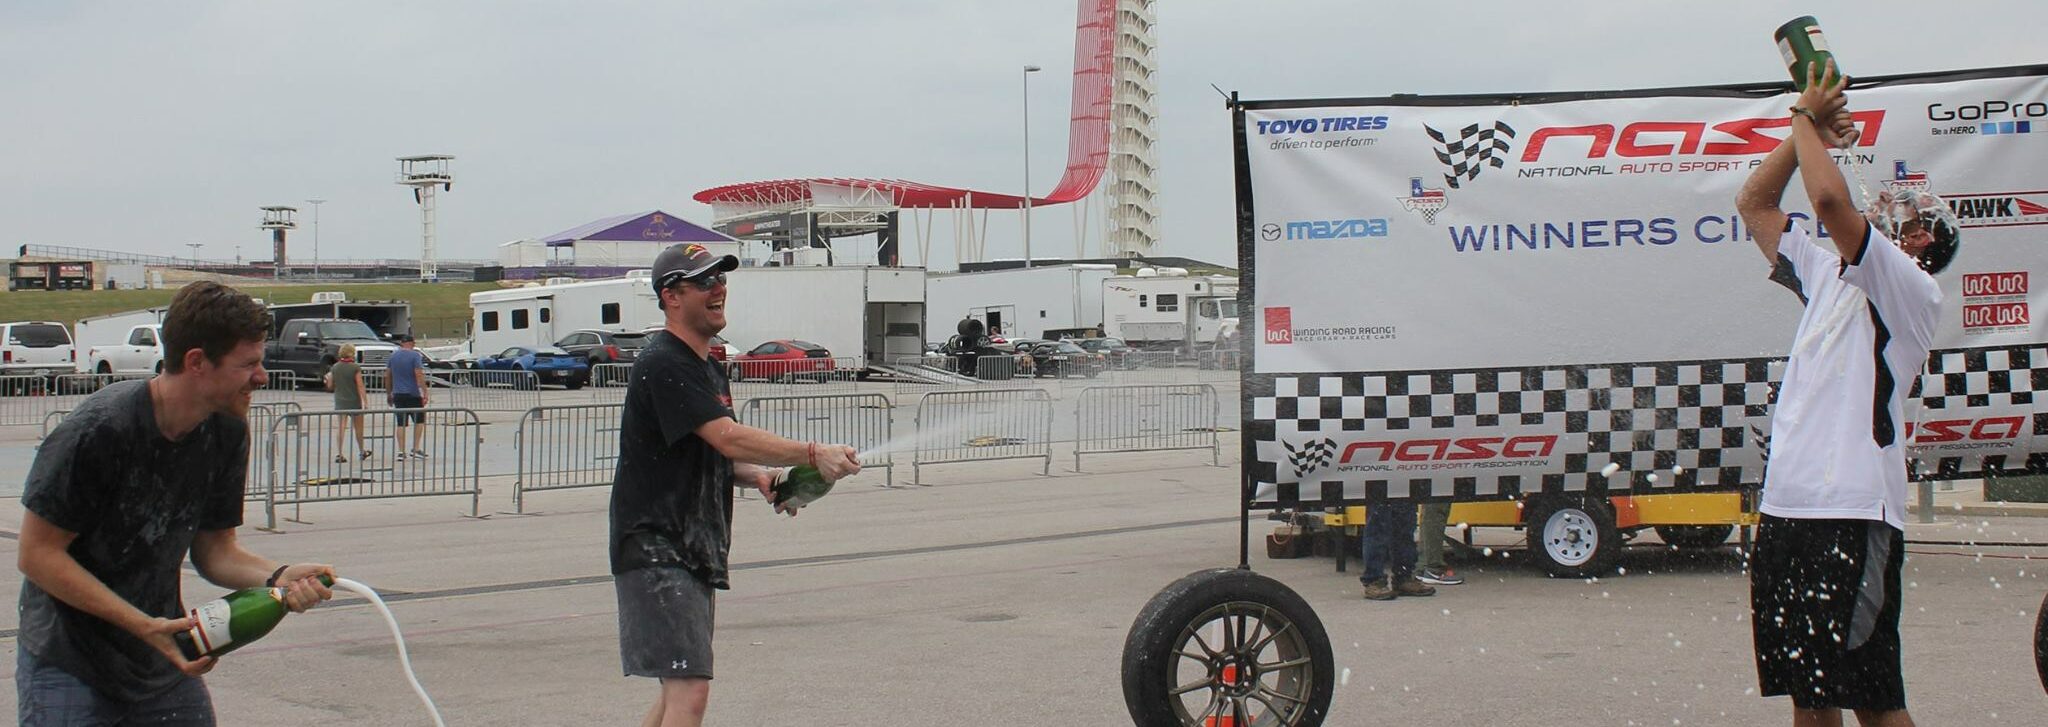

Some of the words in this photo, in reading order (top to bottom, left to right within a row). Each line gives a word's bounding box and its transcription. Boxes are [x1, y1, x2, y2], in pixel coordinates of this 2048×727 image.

[1927, 101, 2048, 121] GoPro
[1257, 119, 1318, 135] TOYO
[1321, 116, 1389, 132] TIRES
[1270, 137, 1310, 150] driven
[1310, 140, 1322, 149] to
[1323, 136, 1375, 151] perform
[1518, 165, 1613, 178] NATIONAL
[1619, 162, 1673, 174] AUTO
[1679, 161, 1742, 172] SPORT
[1448, 217, 1678, 252] WINNERS
[1293, 328, 1331, 337] WINDING
[1332, 327, 1357, 336] ROAD
[1358, 326, 1391, 335] RACING
[1339, 435, 1558, 464] nasa
[1337, 465, 1393, 473] NATIONAL
[1397, 463, 1428, 472] AUTO
[1431, 463, 1471, 471] SPORT
[1473, 460, 1549, 469] ASSOCIATION
